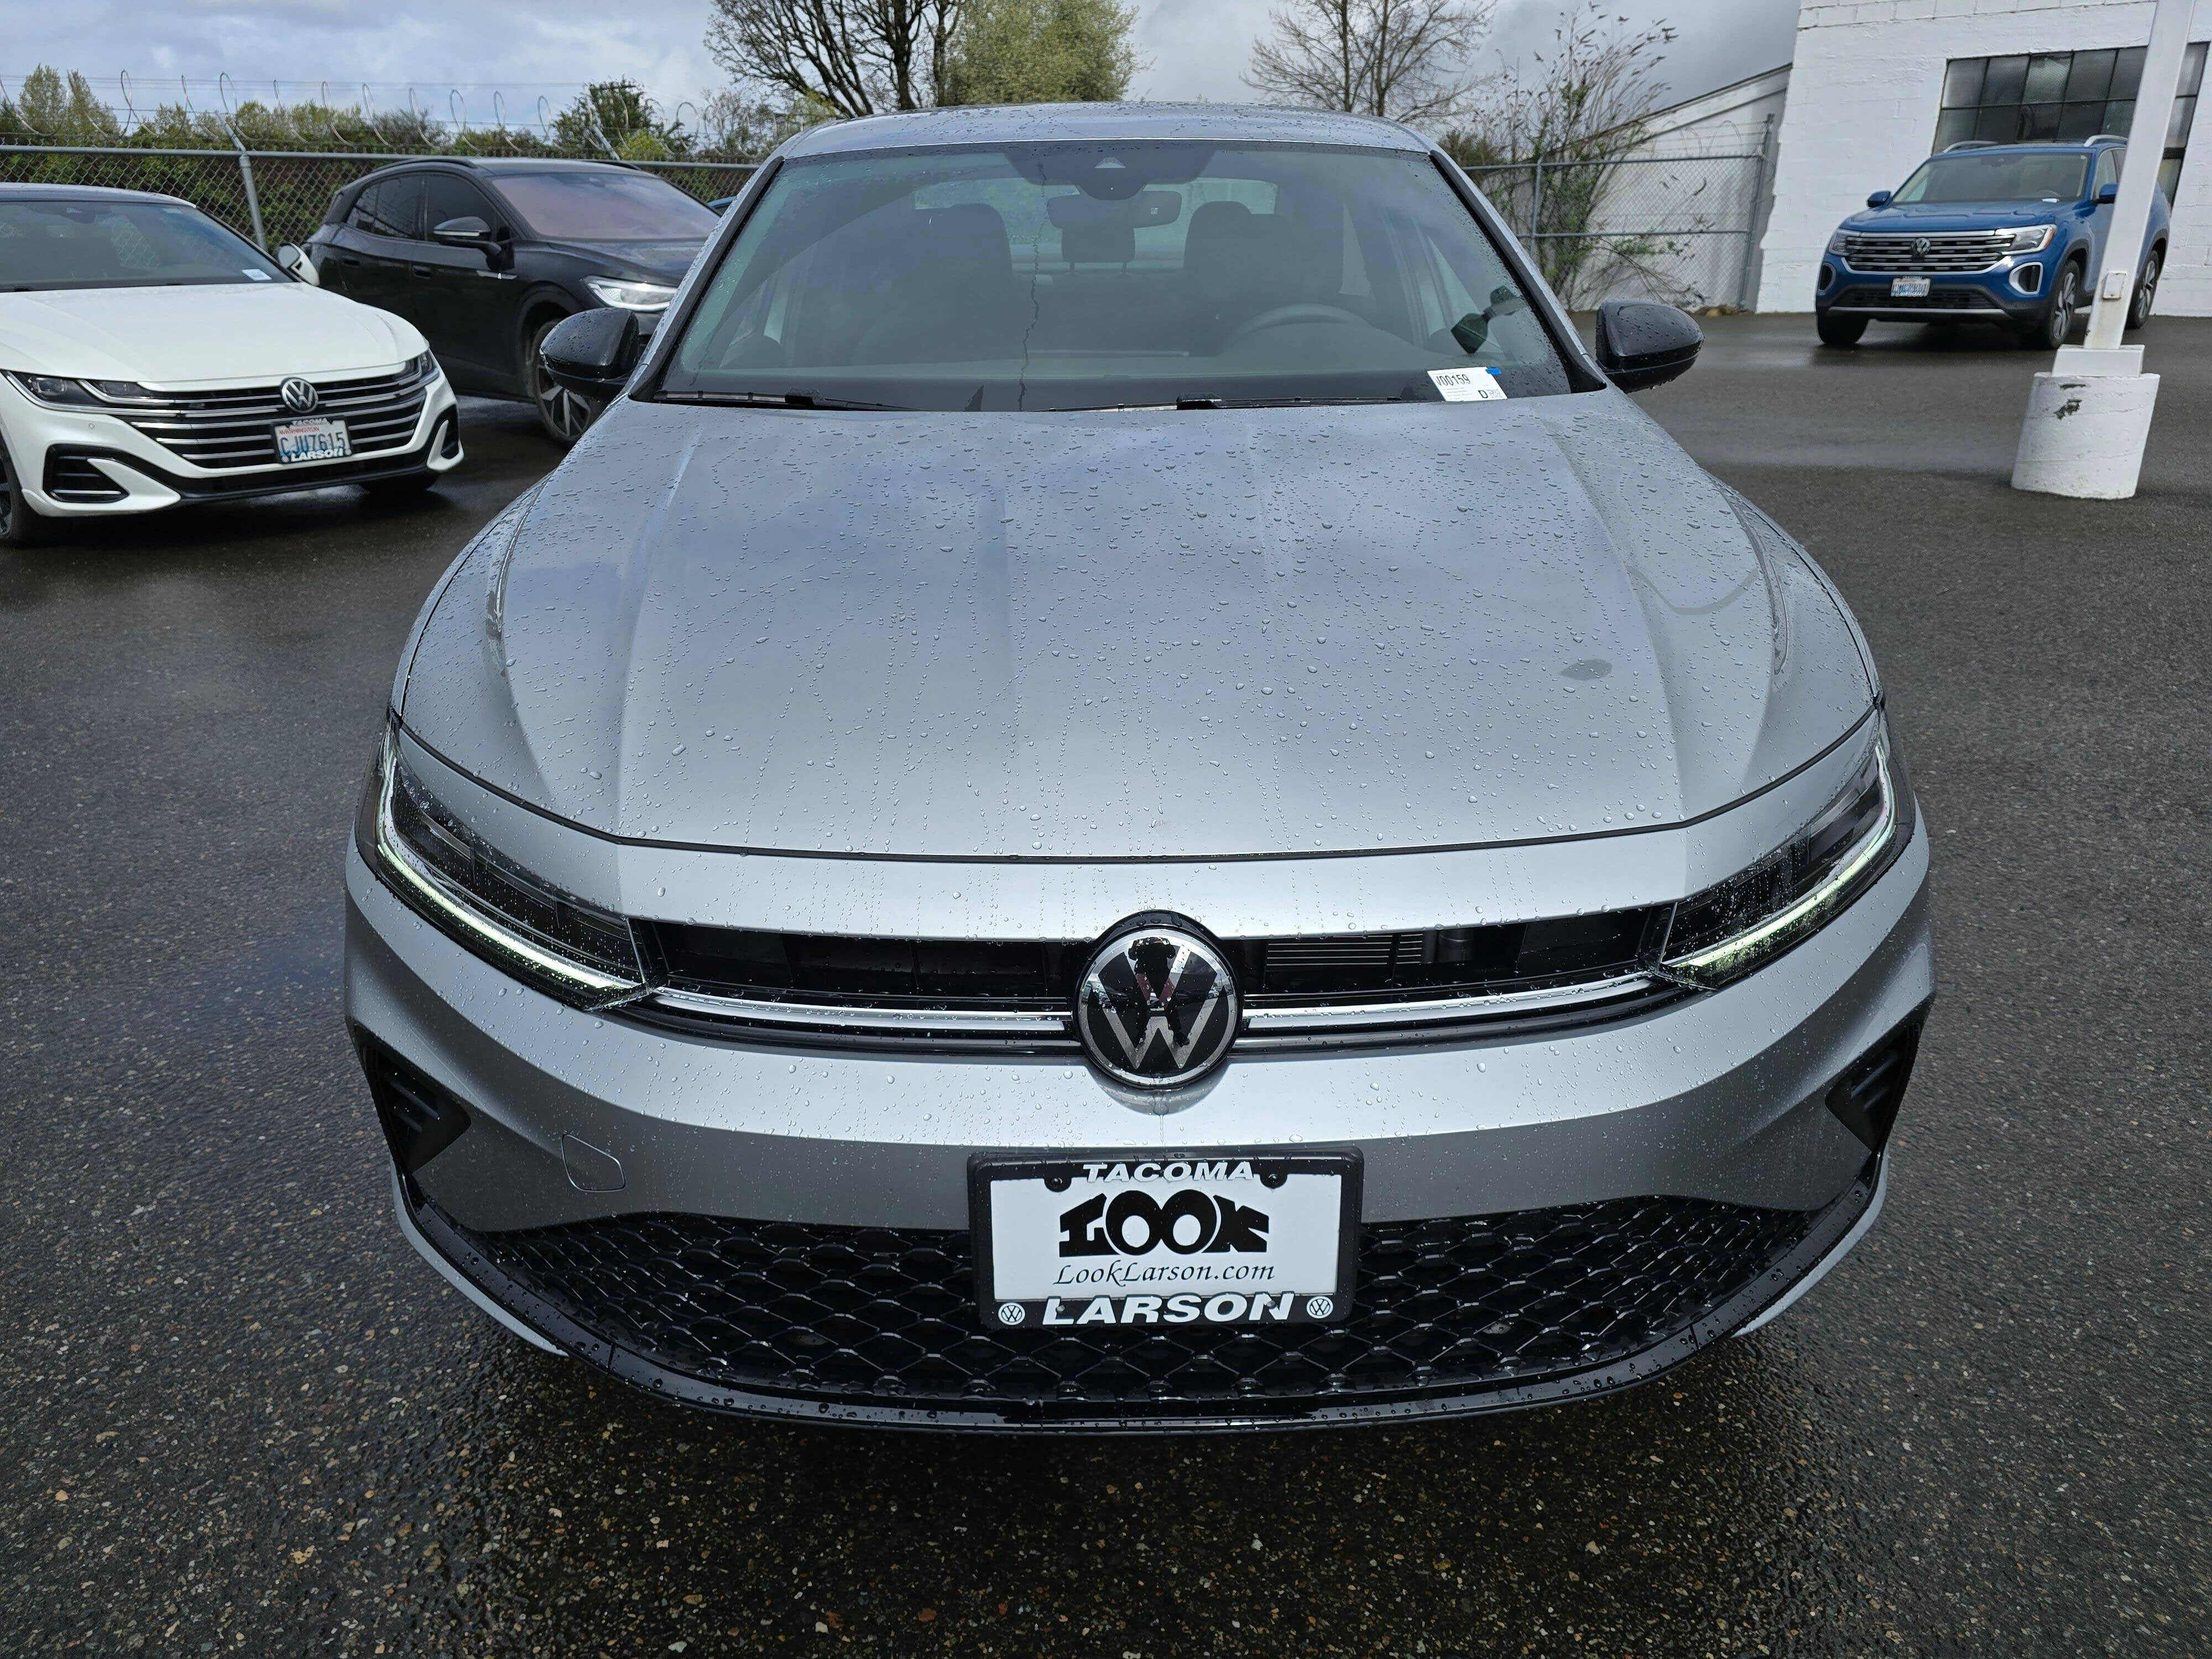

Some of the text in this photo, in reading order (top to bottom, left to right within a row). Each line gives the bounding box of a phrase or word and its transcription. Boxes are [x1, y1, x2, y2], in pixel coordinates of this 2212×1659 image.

[1478, 390, 1489, 399] D
[290, 448, 343, 462] LARSON
[1082, 1161, 1254, 1183] TACOMA
[1059, 1189, 1269, 1258] LOOK
[1052, 1259, 1275, 1287] LookLarson.com
[1042, 1291, 1295, 1325] LARSON
